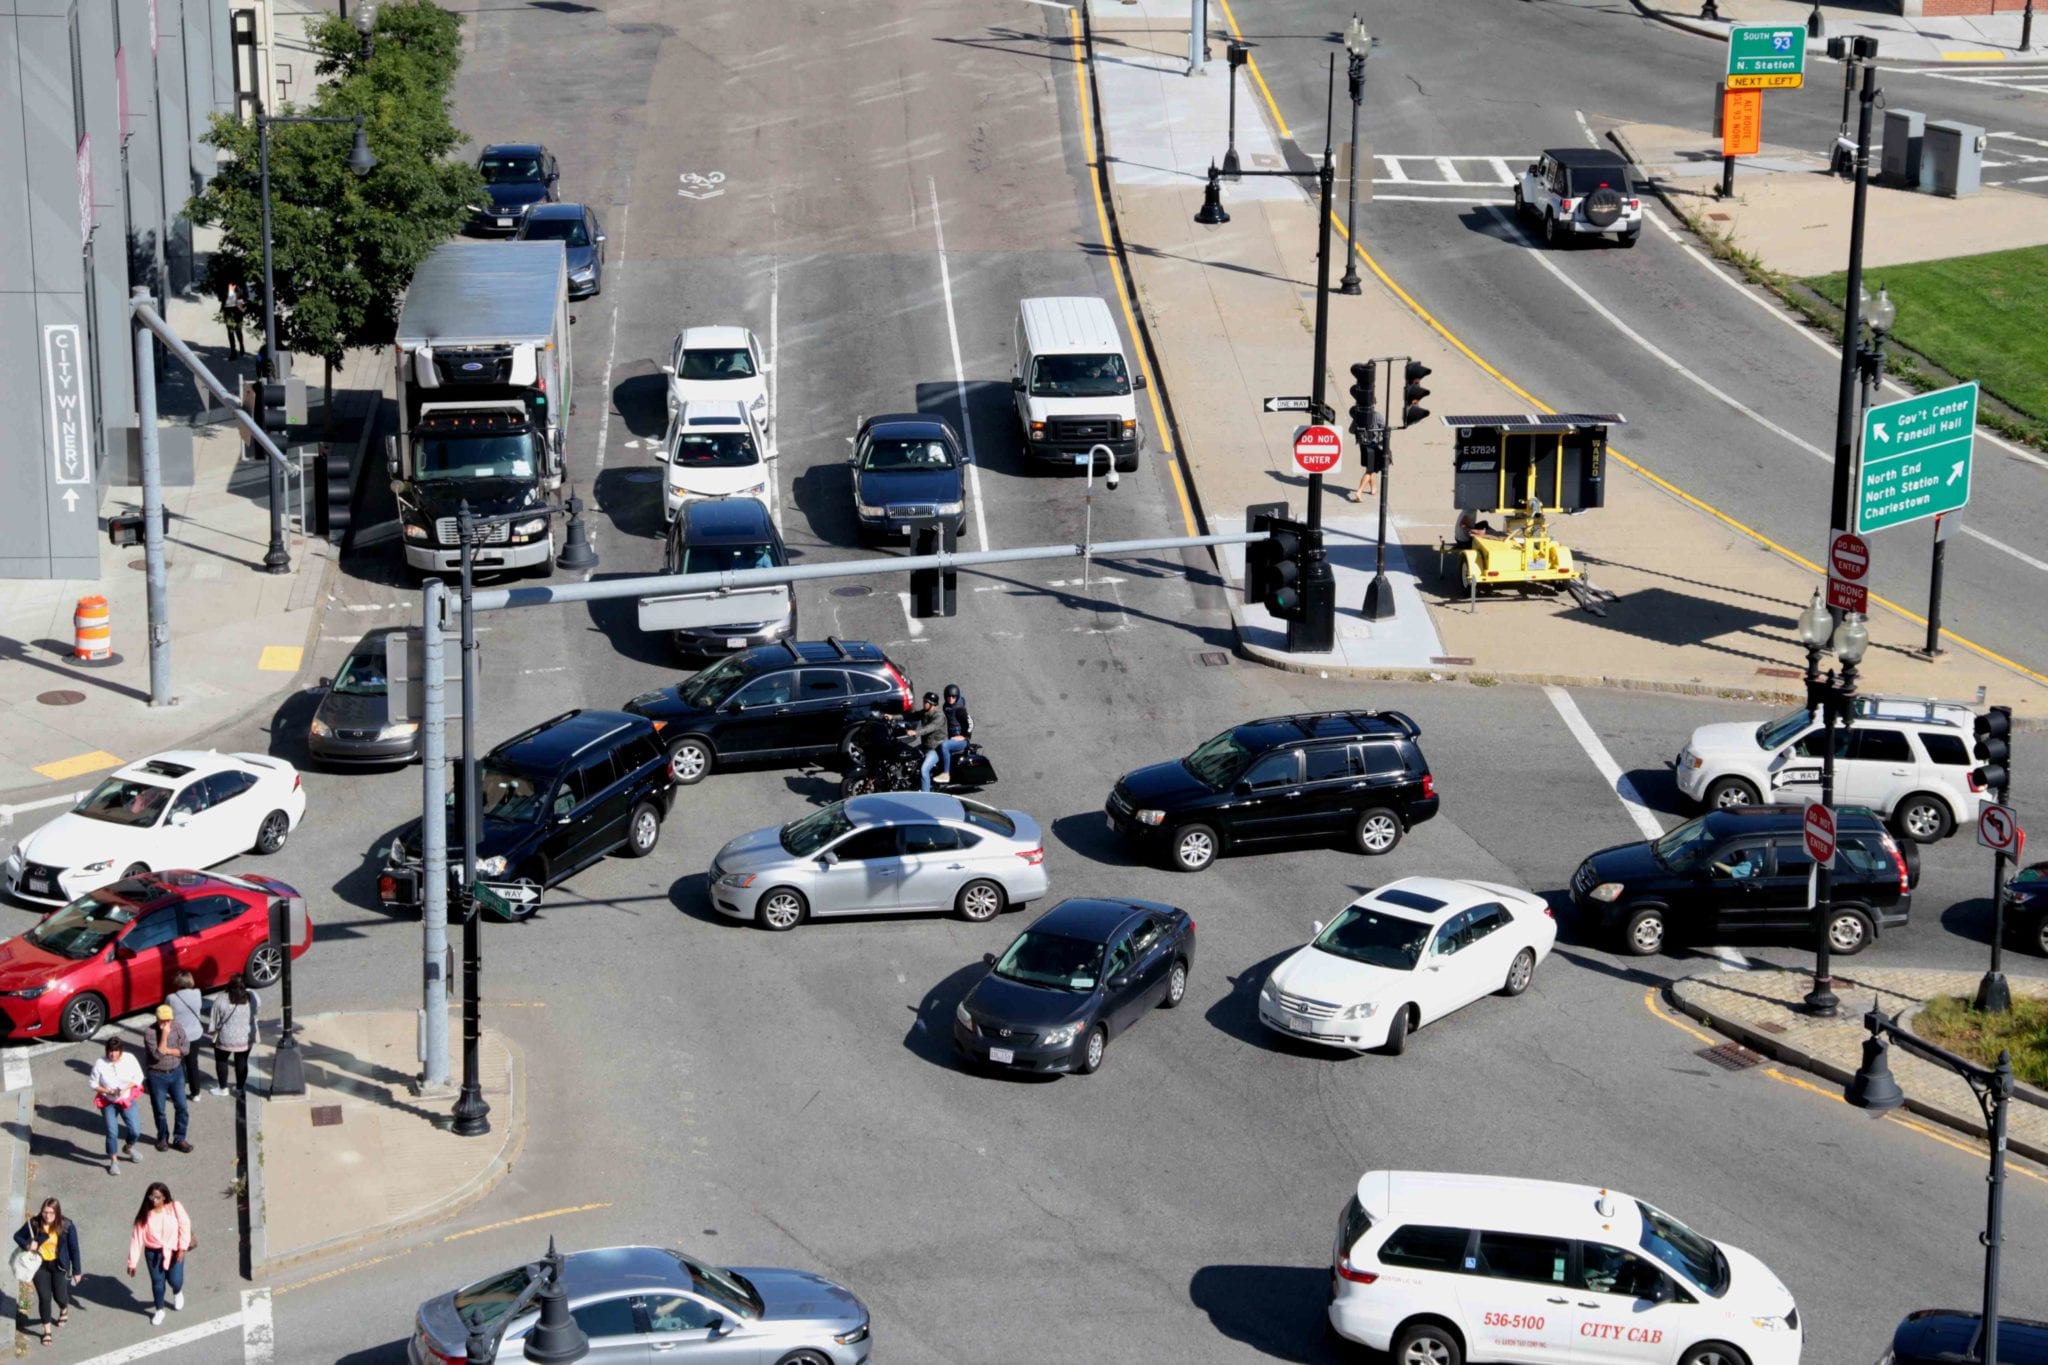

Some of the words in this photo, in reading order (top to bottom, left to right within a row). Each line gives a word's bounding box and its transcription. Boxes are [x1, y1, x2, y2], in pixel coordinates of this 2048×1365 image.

[1743, 32, 1770, 41] SOUTH
[1773, 37, 1791, 50] 93
[1736, 61, 1749, 70] N.
[1754, 61, 1795, 70] Station
[1735, 77, 1762, 86] NEXT
[1768, 77, 1793, 85] LEFT
[1731, 123, 1741, 149] NORTH
[55, 334, 73, 389] CITY
[1898, 410, 1927, 426] Gov't
[1932, 400, 1969, 418] Center
[1940, 417, 1962, 432] Hall
[57, 394, 78, 476] WINERY
[1301, 435, 1313, 443] DO
[1318, 435, 1334, 443] NOT
[1303, 456, 1331, 464] ENTER
[1867, 469, 1897, 486] North
[1901, 462, 1922, 477] End
[1865, 486, 1896, 503] North
[1900, 475, 1939, 493] Station
[1865, 494, 1930, 519] Charlestown
[1837, 540, 1848, 550] DO
[1850, 543, 1865, 553] NOT
[1838, 561, 1861, 573] ENTER
[1833, 582, 1864, 598] WRONG
[1799, 772, 1817, 780] WAY
[1809, 810, 1818, 822] DO
[1820, 817, 1831, 831] NOT
[1810, 836, 1828, 854] ENTER
[1483, 1312, 1545, 1330] 536-5100
[1580, 1322, 1625, 1340] CITY
[1627, 1328, 1664, 1344] CAB
